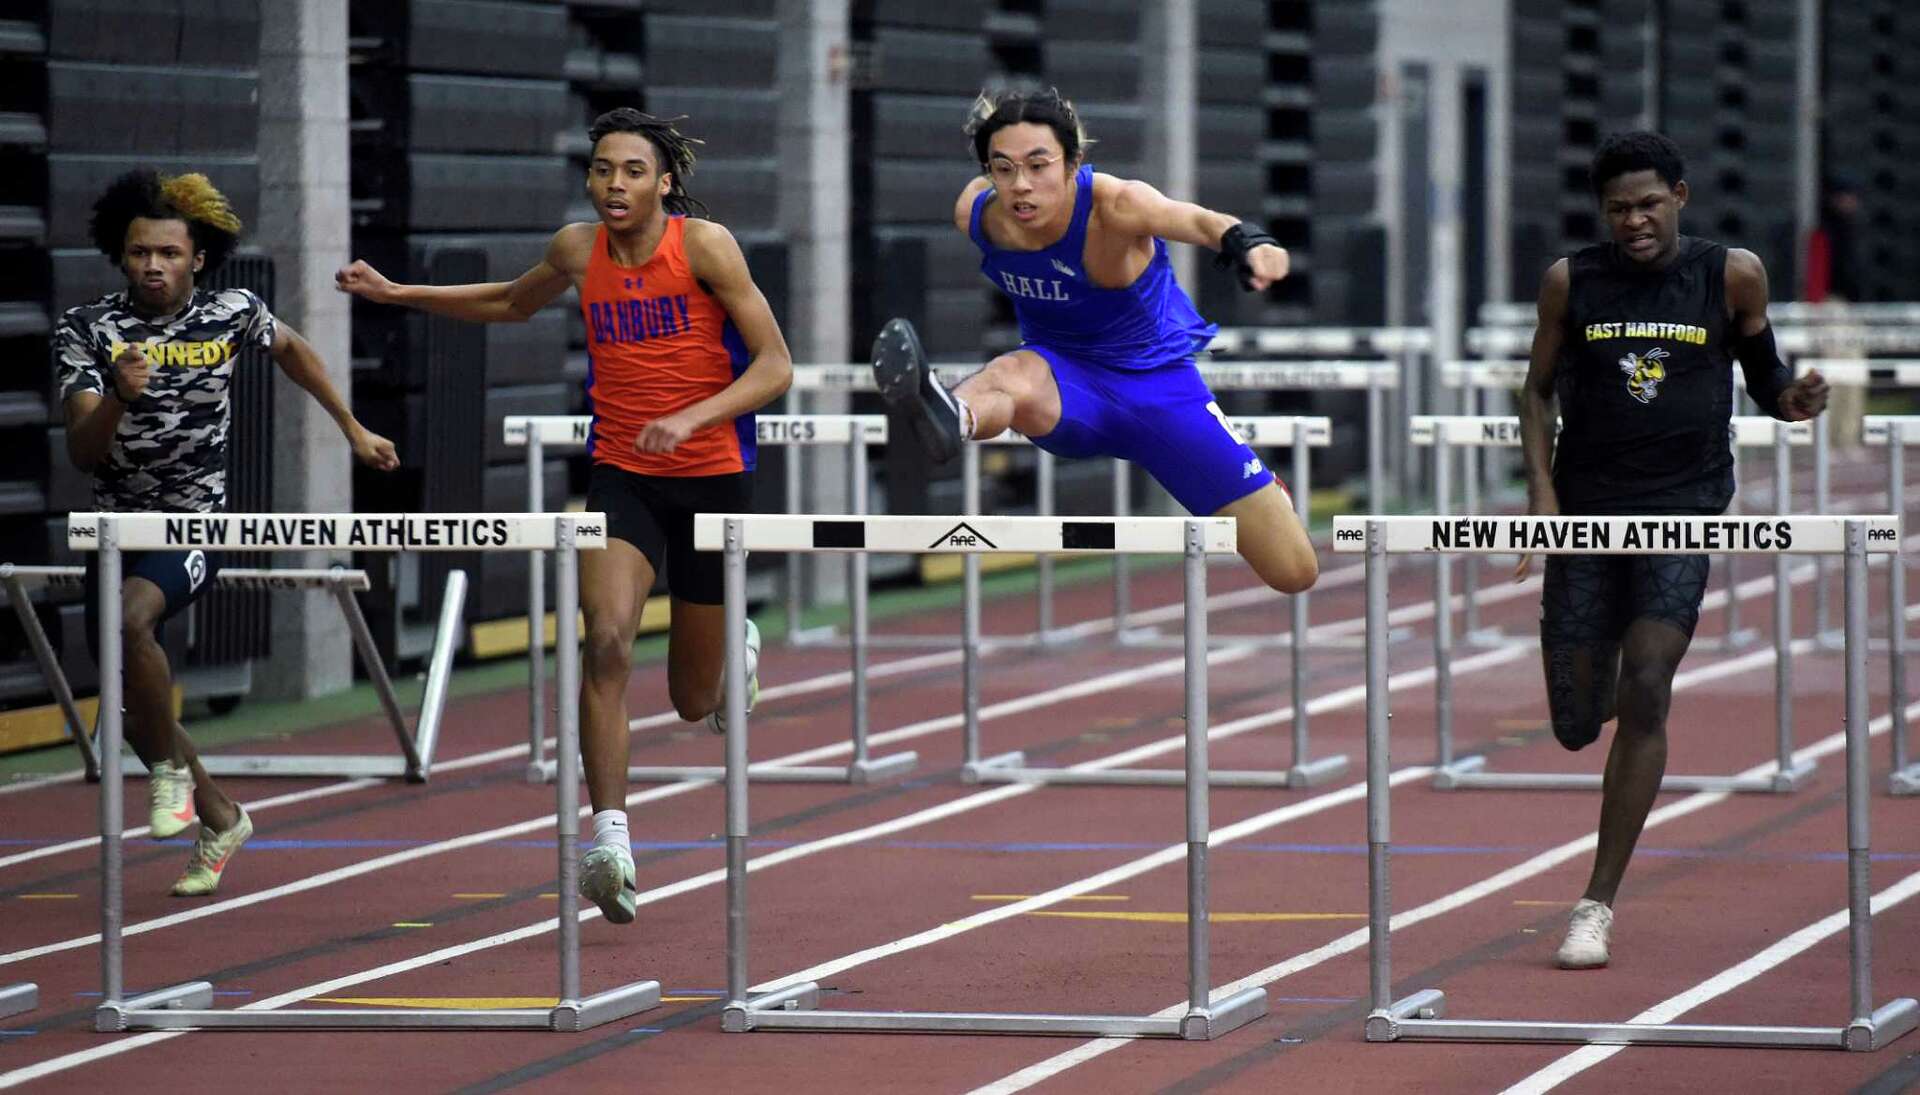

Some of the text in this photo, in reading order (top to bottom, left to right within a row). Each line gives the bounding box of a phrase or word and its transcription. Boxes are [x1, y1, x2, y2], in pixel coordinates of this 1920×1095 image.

[1000, 271, 1069, 301] HALL
[590, 294, 691, 344] DANBURY
[1585, 322, 1707, 345] EAST HARTFORD
[165, 518, 508, 546] NEW HAVEN ATHLETICS
[1432, 520, 1793, 550] NEW HAVEN ATHLETICS
